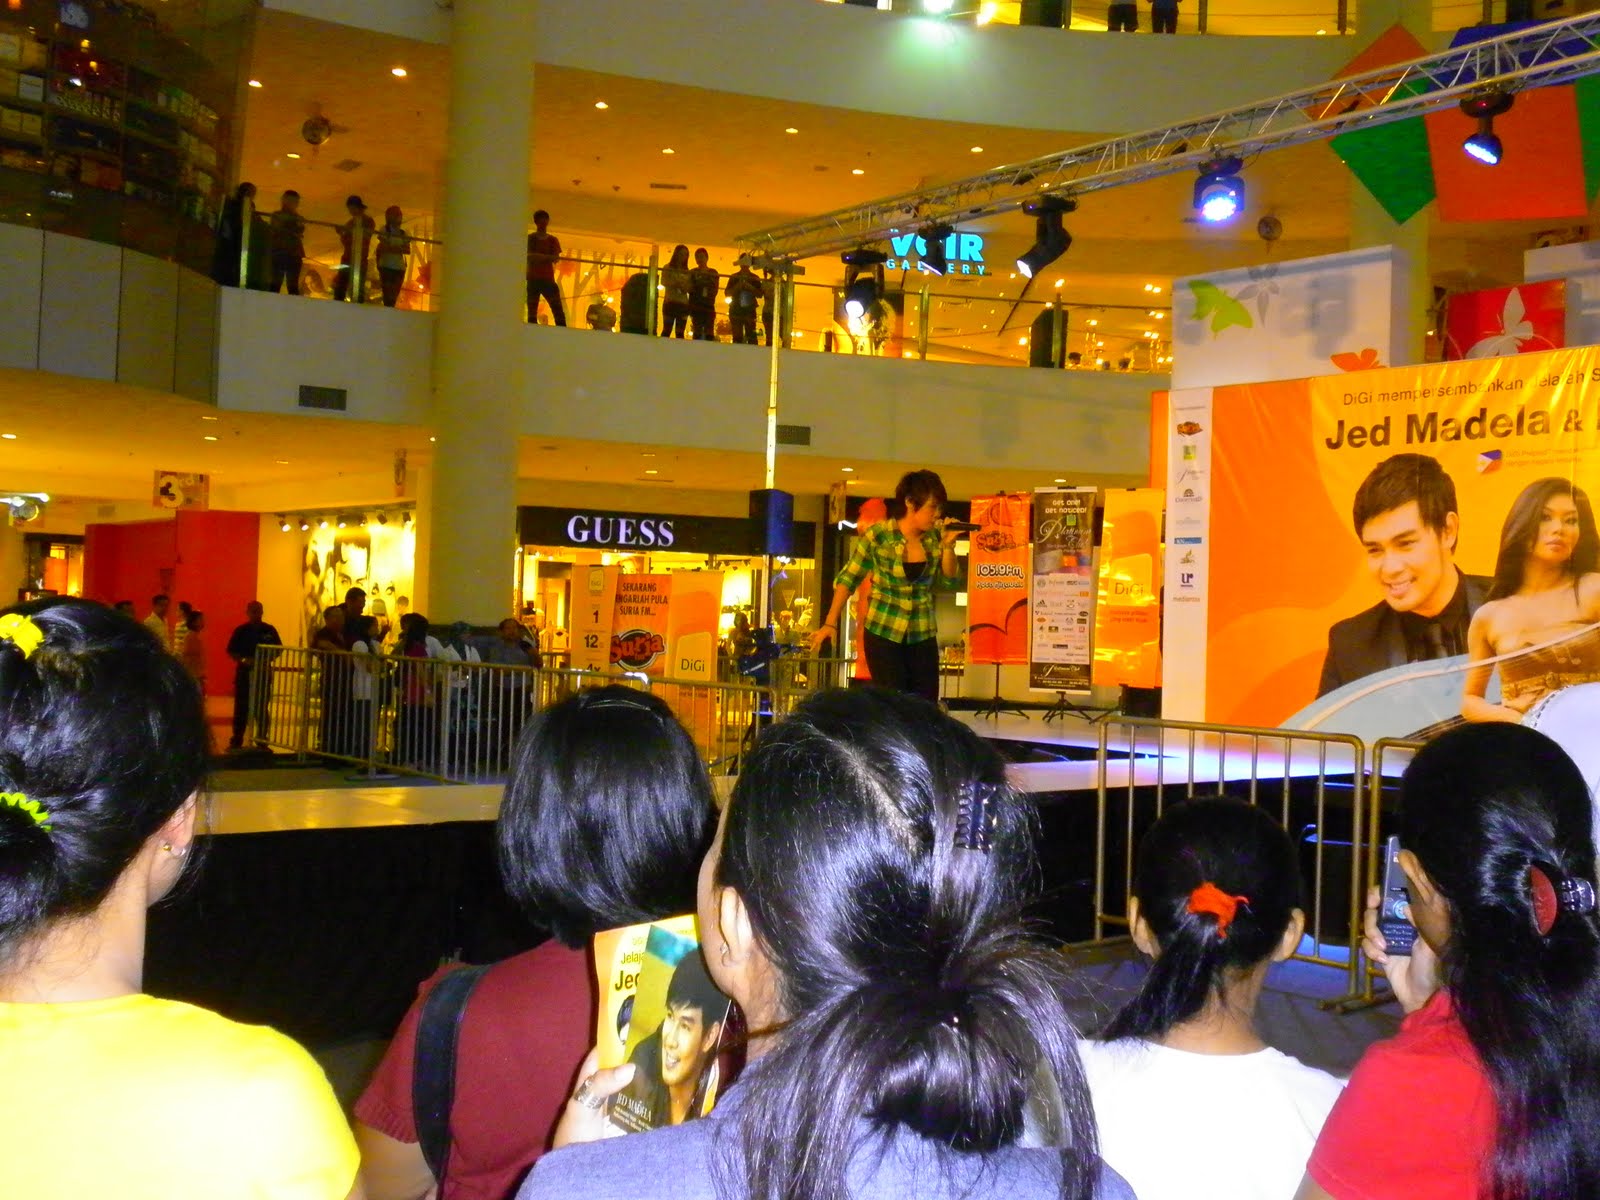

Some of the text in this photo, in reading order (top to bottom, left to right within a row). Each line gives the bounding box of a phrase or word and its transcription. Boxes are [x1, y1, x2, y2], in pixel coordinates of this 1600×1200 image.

[885, 258, 986, 276] GALERY
[1343, 391, 1373, 406] DiGi
[1325, 415, 1391, 450] Jed
[1406, 405, 1551, 444] Madela
[1563, 408, 1583, 432] &
[567, 515, 675, 547] GUESS
[622, 582, 657, 592] SEKARANG
[1114, 582, 1144, 597] DiGi
[650, 595, 668, 604] PULA
[592, 610, 599, 624] 1
[584, 634, 599, 648] 12
[681, 658, 705, 672] DiGi
